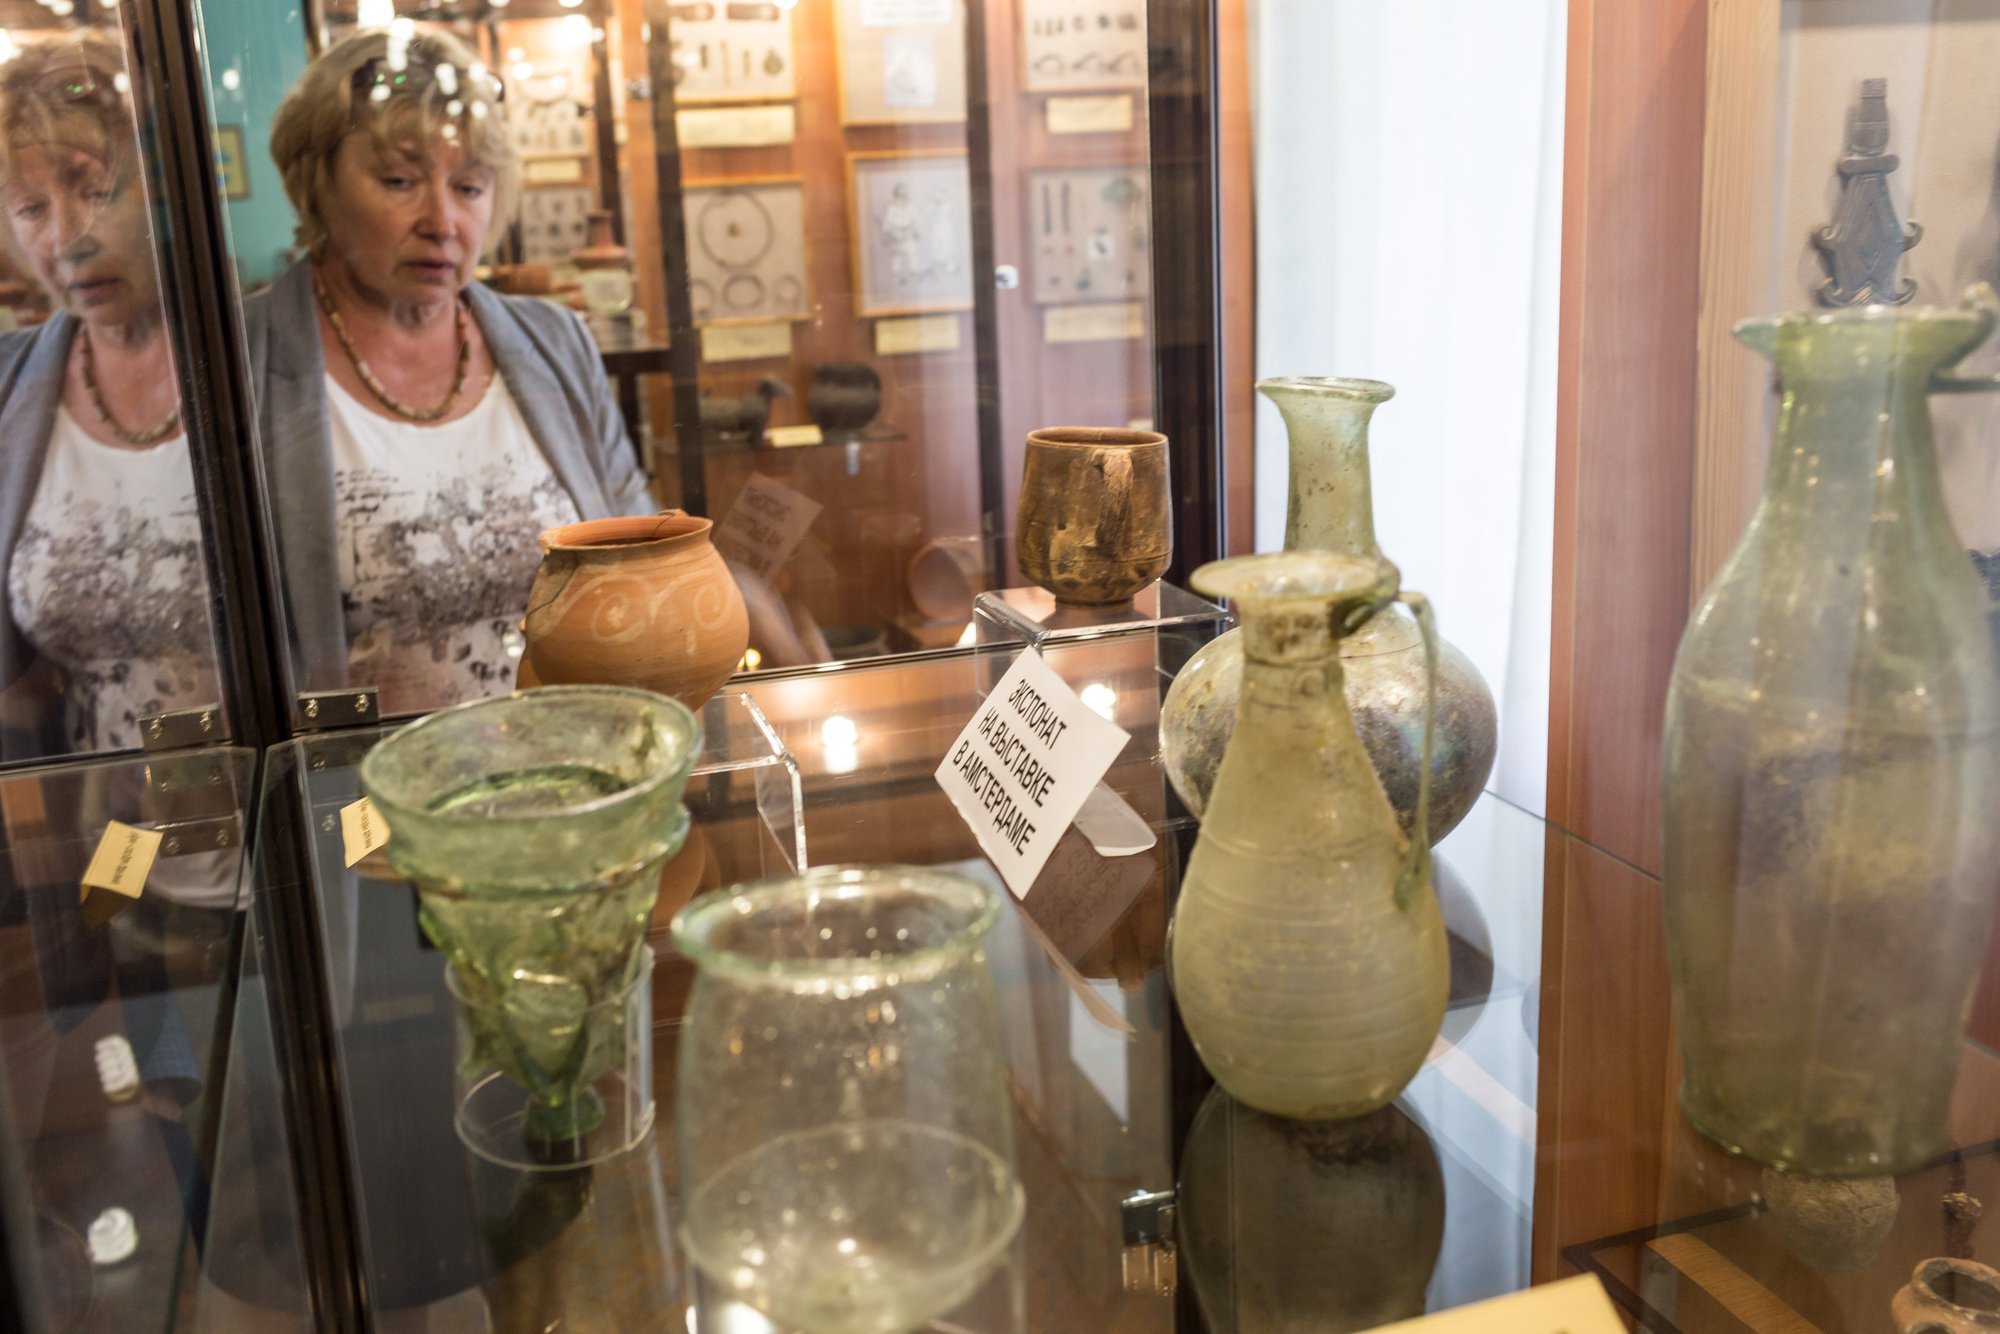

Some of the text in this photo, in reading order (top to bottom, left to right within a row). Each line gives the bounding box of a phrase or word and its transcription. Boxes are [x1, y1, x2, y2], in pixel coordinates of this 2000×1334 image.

[977, 707, 1056, 808] НА ВЫСТАВКЕ
[1008, 678, 1067, 750] ЭКСПОНАТ
[952, 739, 1036, 857] В АМСТЕРДАМЕ
